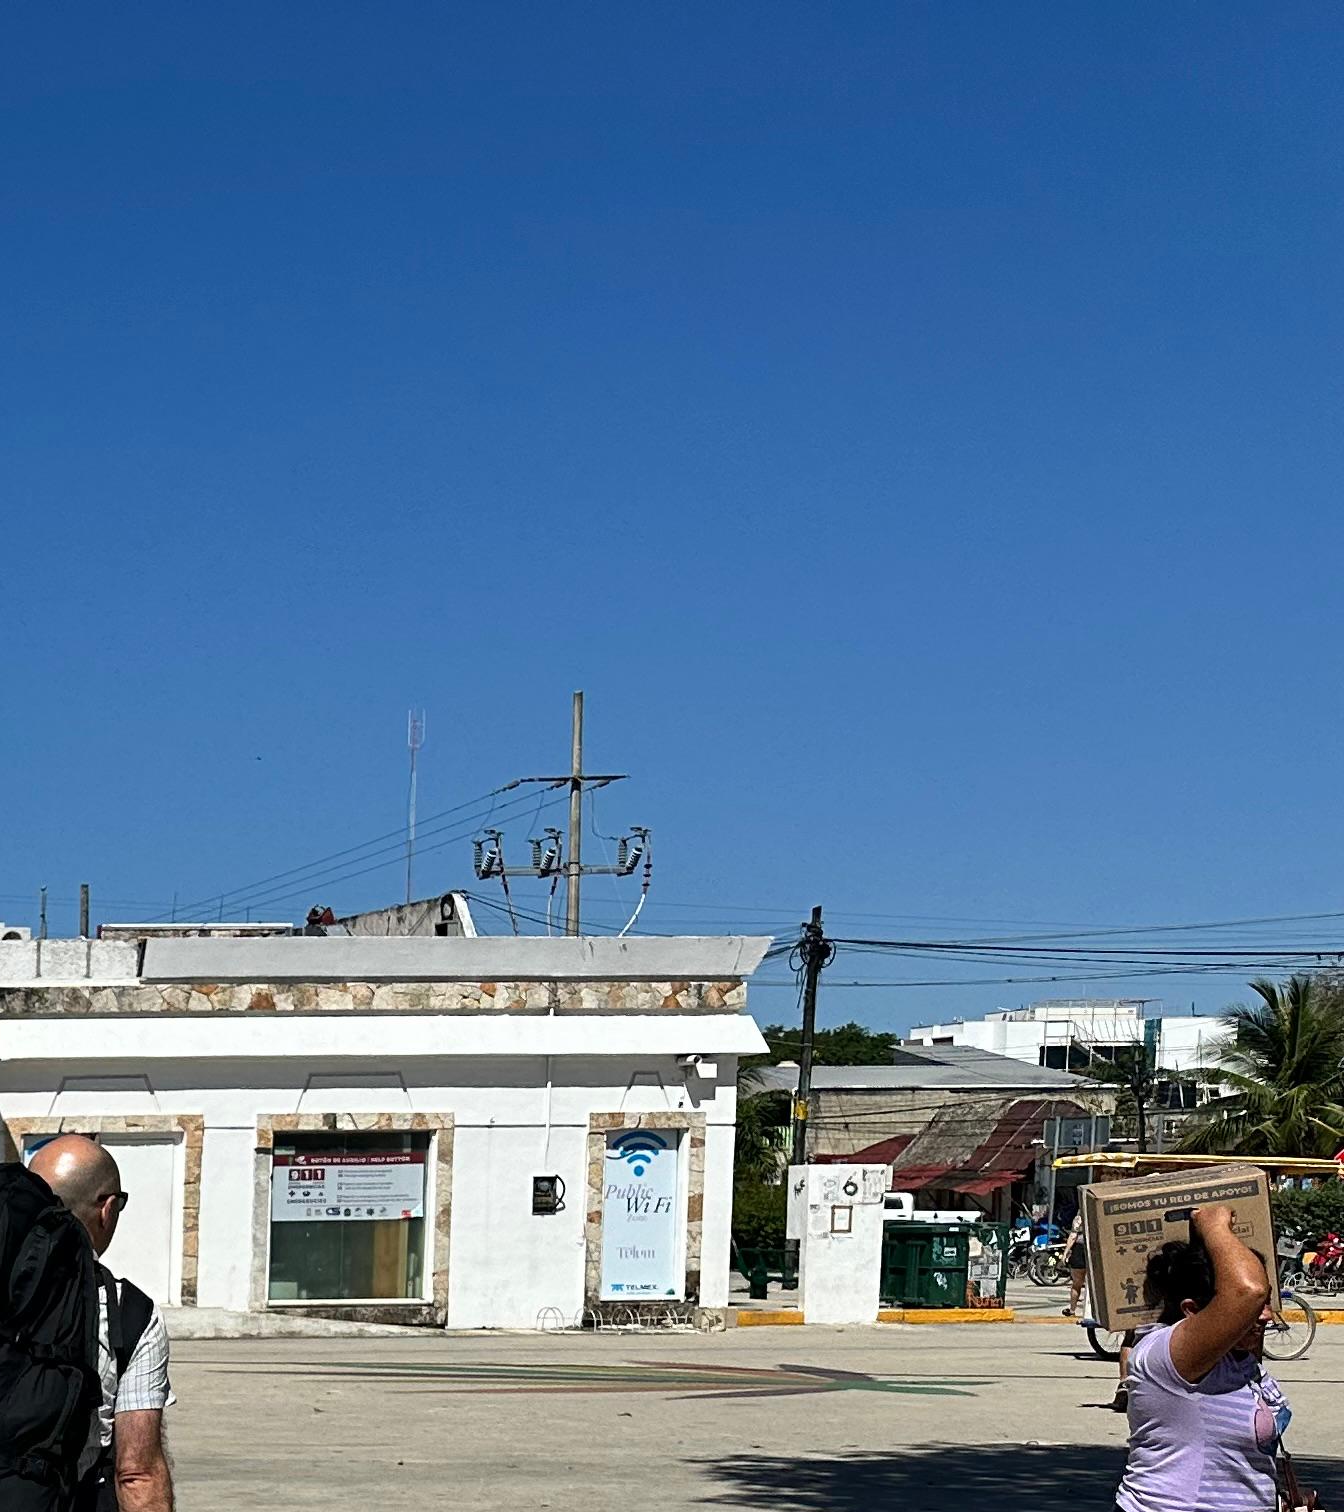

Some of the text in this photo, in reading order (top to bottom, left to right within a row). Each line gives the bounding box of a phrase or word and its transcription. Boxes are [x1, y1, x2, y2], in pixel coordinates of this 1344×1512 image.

[290, 1169, 323, 1180] 911
[605, 1183, 654, 1200] Public
[1153, 1197, 1167, 1206] TU
[1169, 1194, 1192, 1204] RED
[1194, 1191, 1209, 1201] DE
[1211, 1185, 1253, 1198] APOYO!
[1116, 1220, 1158, 1236] 911
